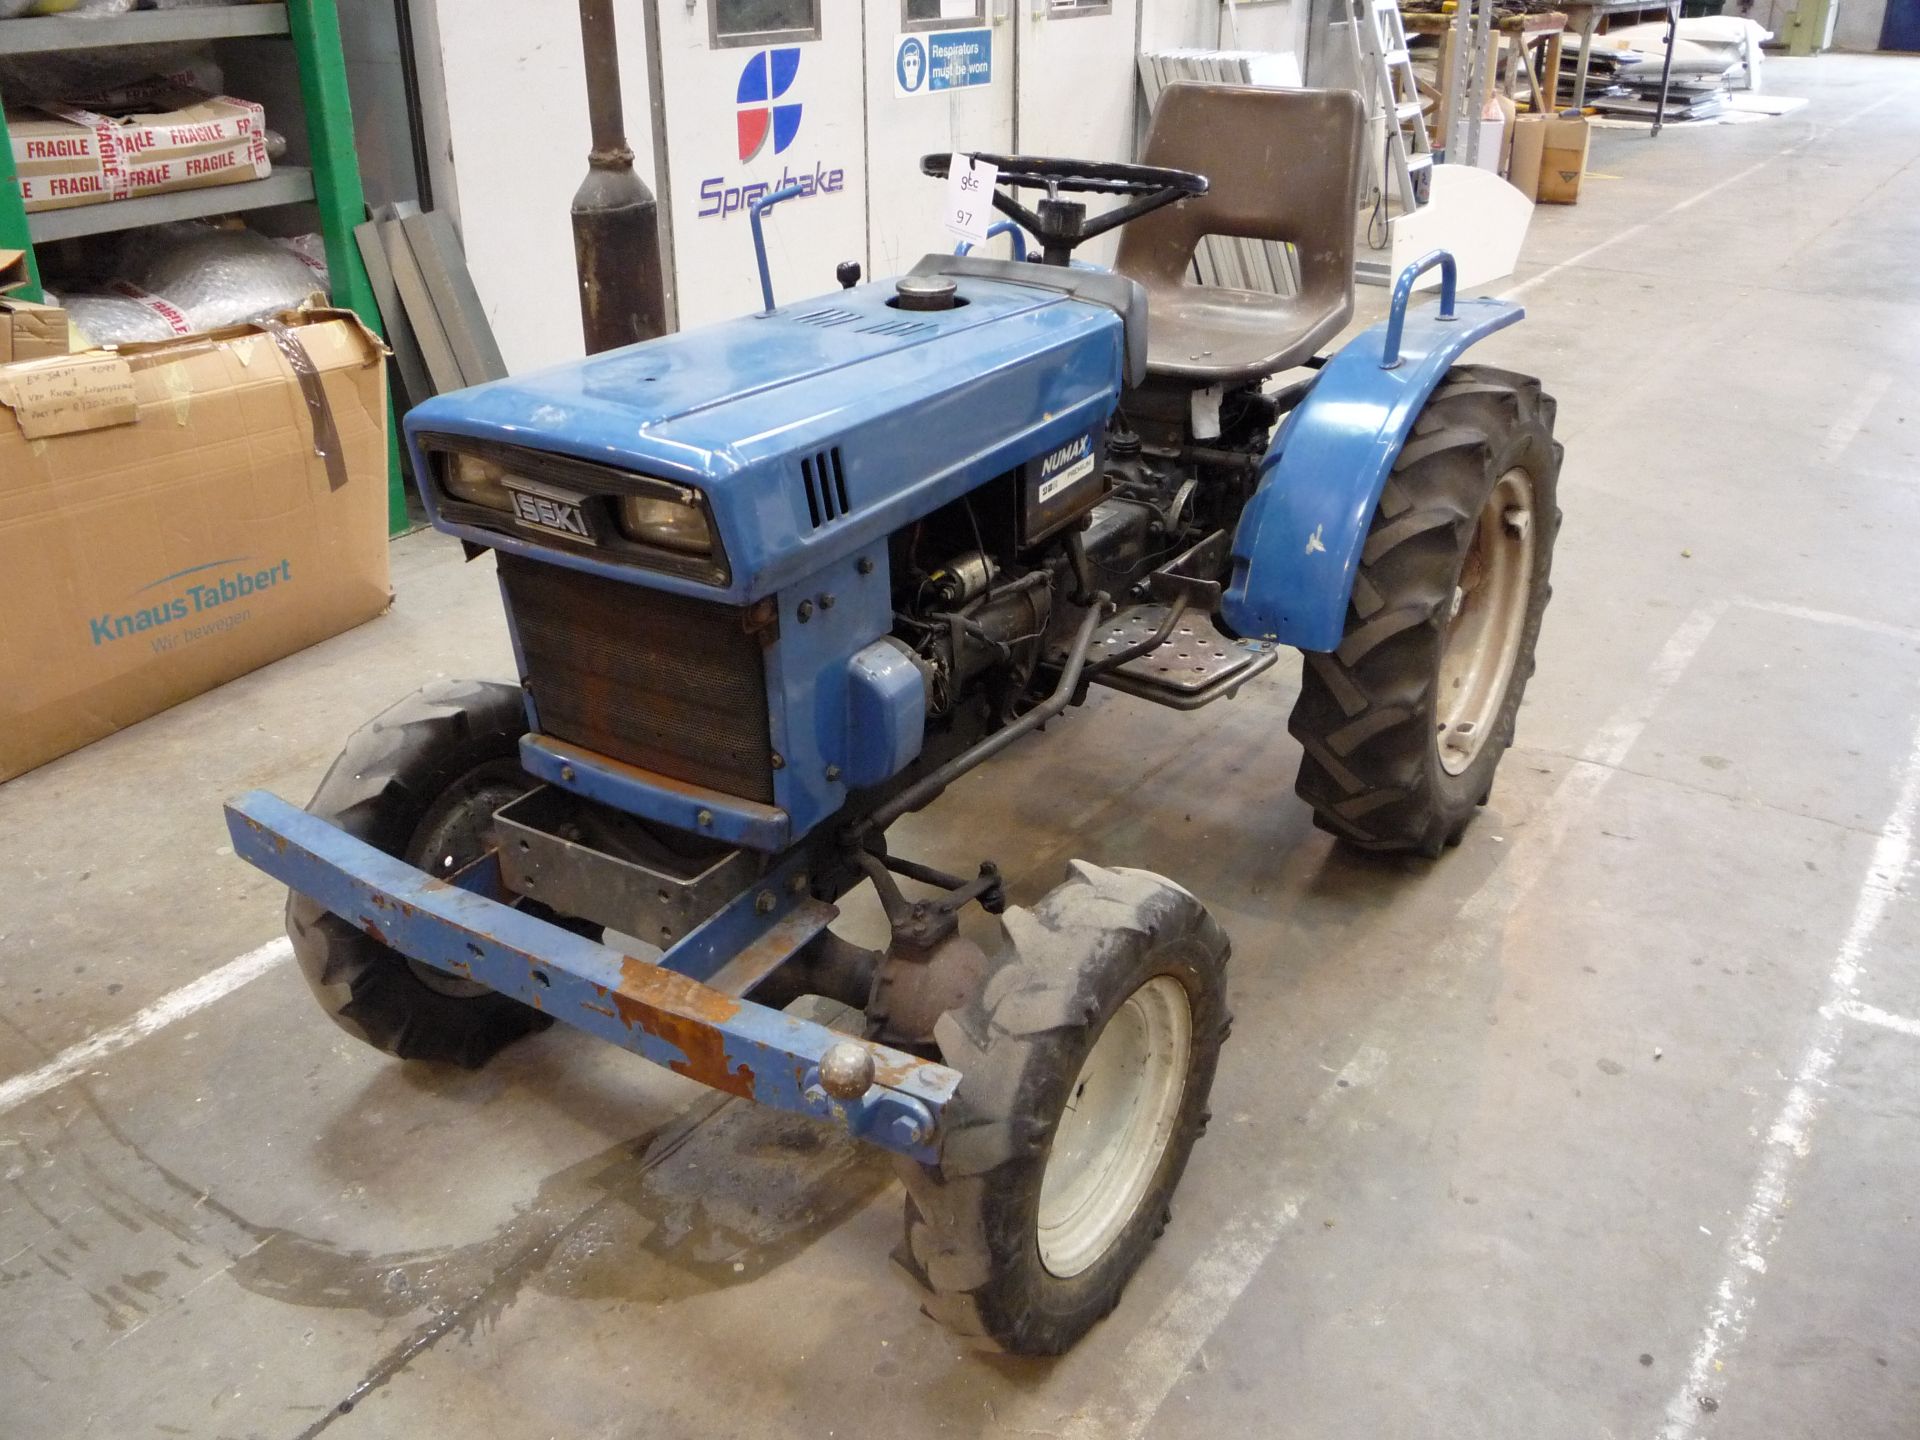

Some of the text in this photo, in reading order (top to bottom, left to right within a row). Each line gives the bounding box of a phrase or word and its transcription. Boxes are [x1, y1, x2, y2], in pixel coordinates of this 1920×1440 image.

[932, 42, 979, 58] Respirators
[932, 62, 988, 79] must be worn
[26, 138, 90, 159] FRAGILE
[170, 123, 226, 145] FRAGILE
[185, 151, 236, 176] FRAGILE
[956, 209, 973, 226] 97
[151, 301, 191, 335] FRAGILE
[1041, 433, 1089, 477] NUMAX
[508, 490, 588, 537] ISEKI
[89, 559, 292, 646] Knaus Tabbert
[150, 609, 251, 655] Wir bewegen
